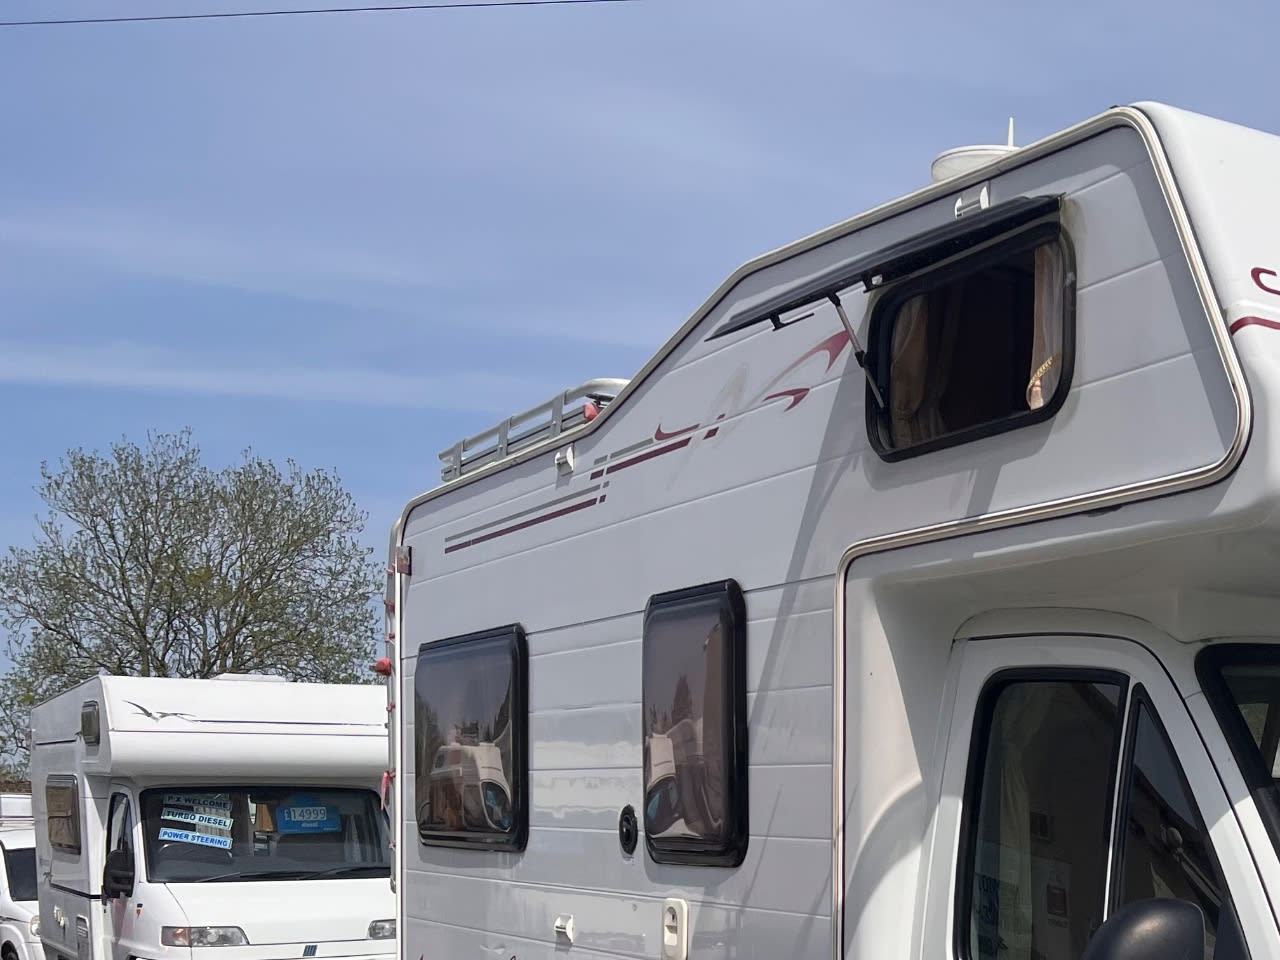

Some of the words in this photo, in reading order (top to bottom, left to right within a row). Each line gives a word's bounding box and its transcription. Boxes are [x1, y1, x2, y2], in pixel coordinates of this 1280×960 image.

[184, 797, 229, 809] WELCOME
[166, 810, 196, 821] TURBO
[198, 815, 228, 827] DIESEL
[162, 830, 190, 840] POWER
[191, 834, 228, 847] STEERING
